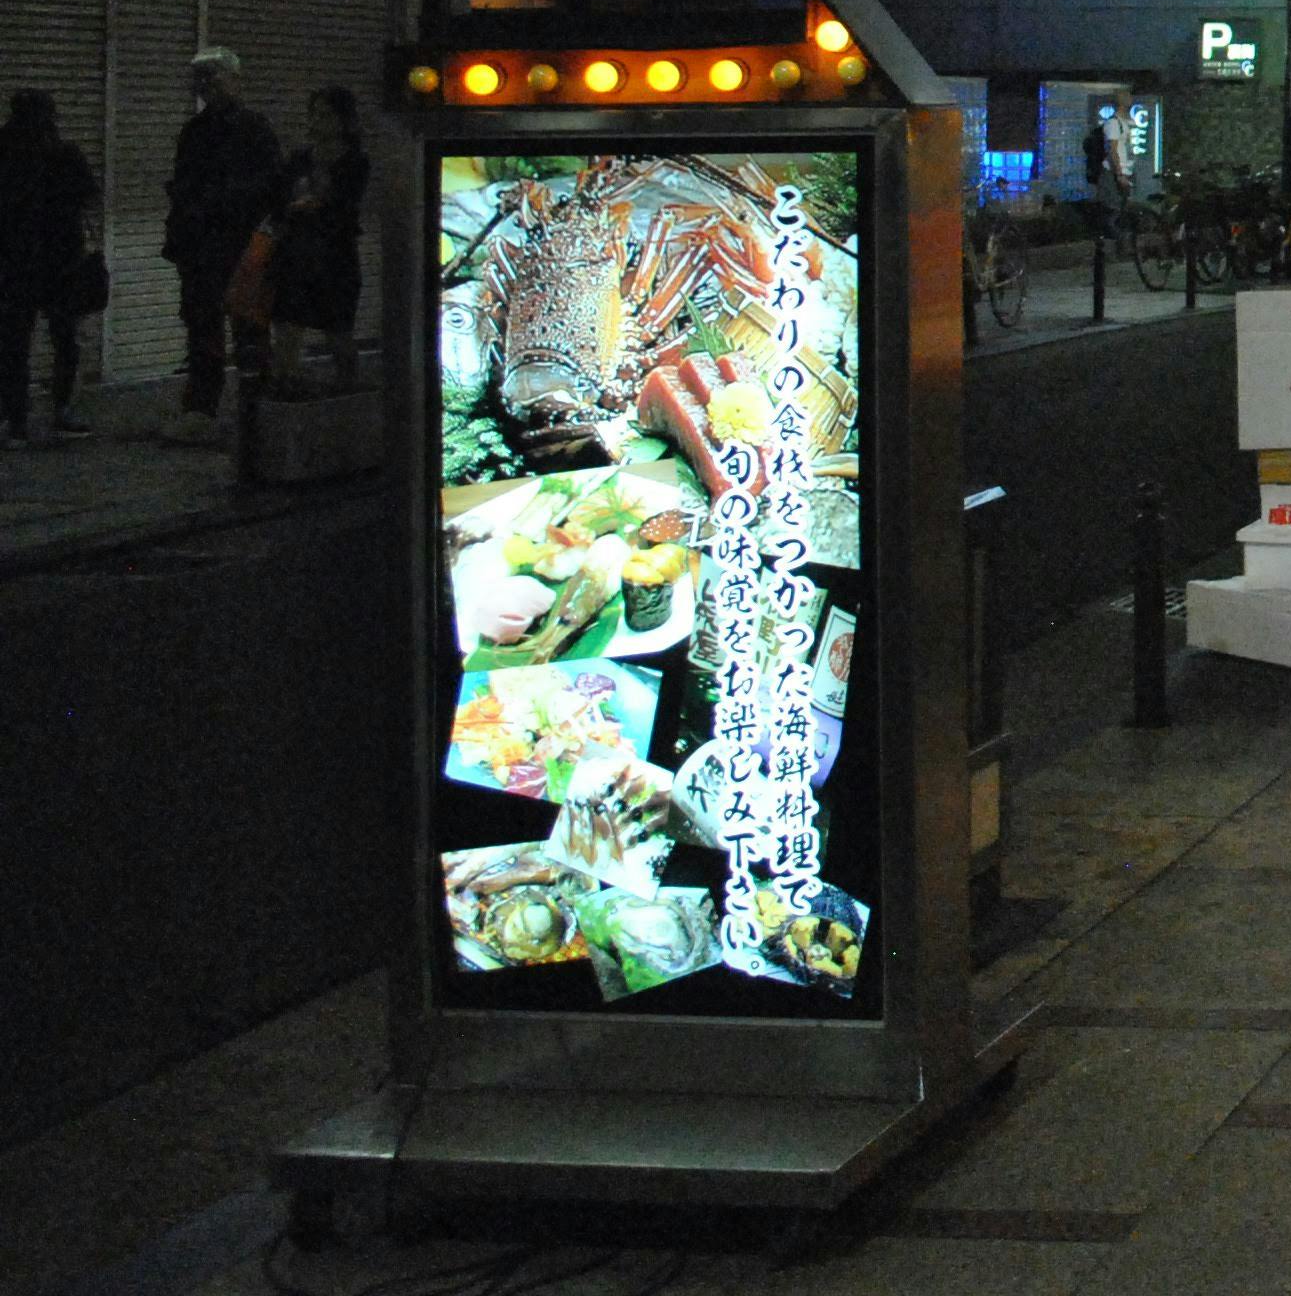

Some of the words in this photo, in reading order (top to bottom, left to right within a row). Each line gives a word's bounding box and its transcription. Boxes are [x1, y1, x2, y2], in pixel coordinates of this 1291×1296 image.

[1203, 23, 1232, 60] P
[718, 445, 762, 974] 旬の味覚をお楽しみ下さい。
